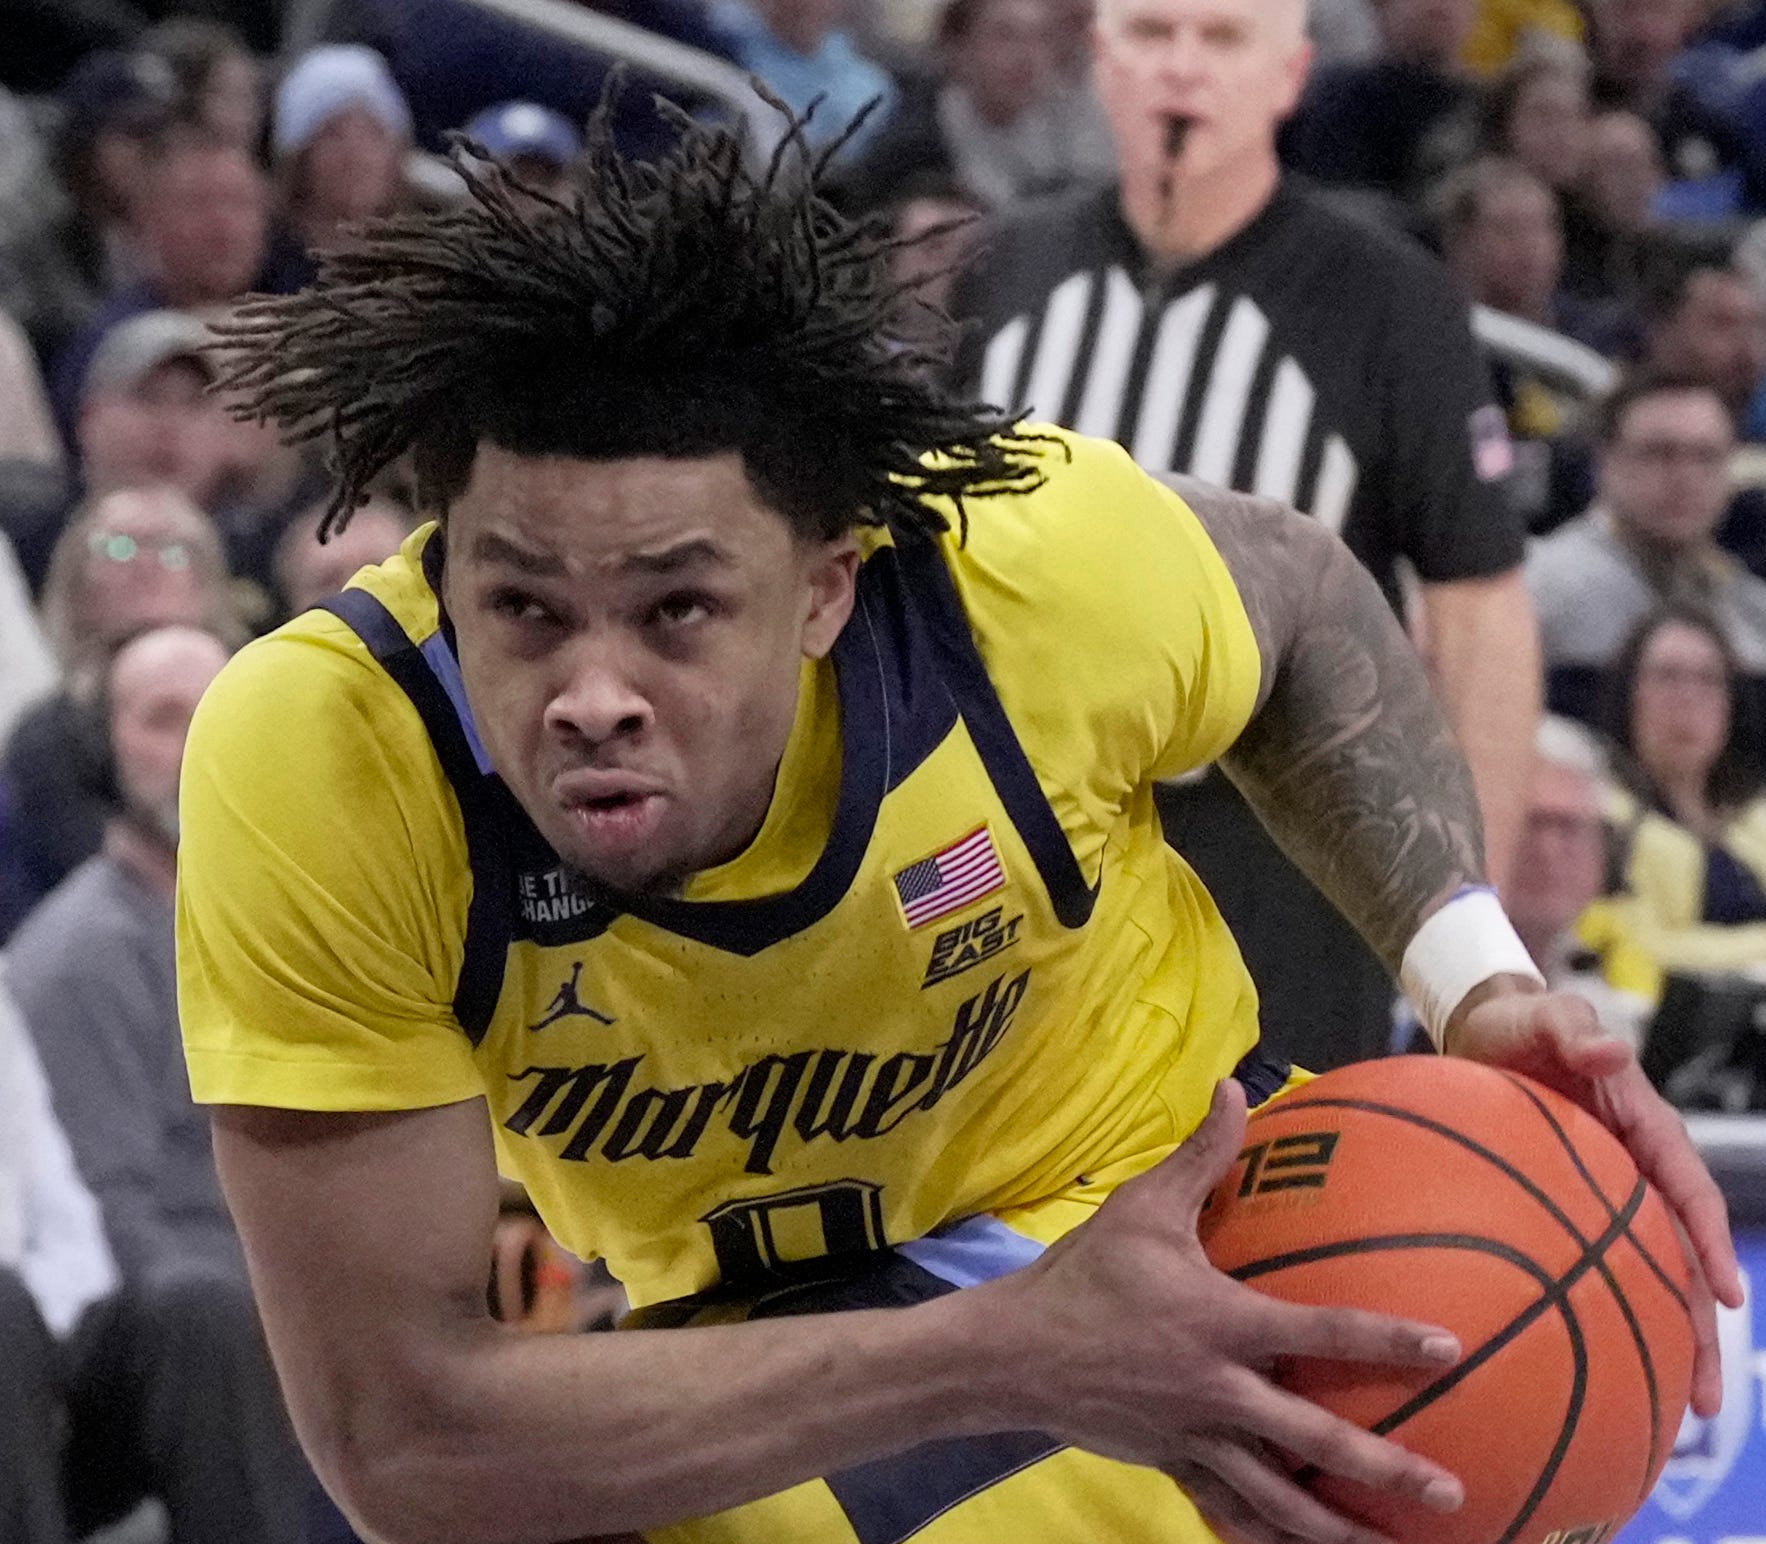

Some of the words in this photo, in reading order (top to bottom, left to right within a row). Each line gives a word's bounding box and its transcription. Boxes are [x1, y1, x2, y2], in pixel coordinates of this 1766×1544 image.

[925, 914, 1024, 980] EAST
[933, 905, 1004, 959] BIG
[504, 966, 1032, 1175] Marquette
